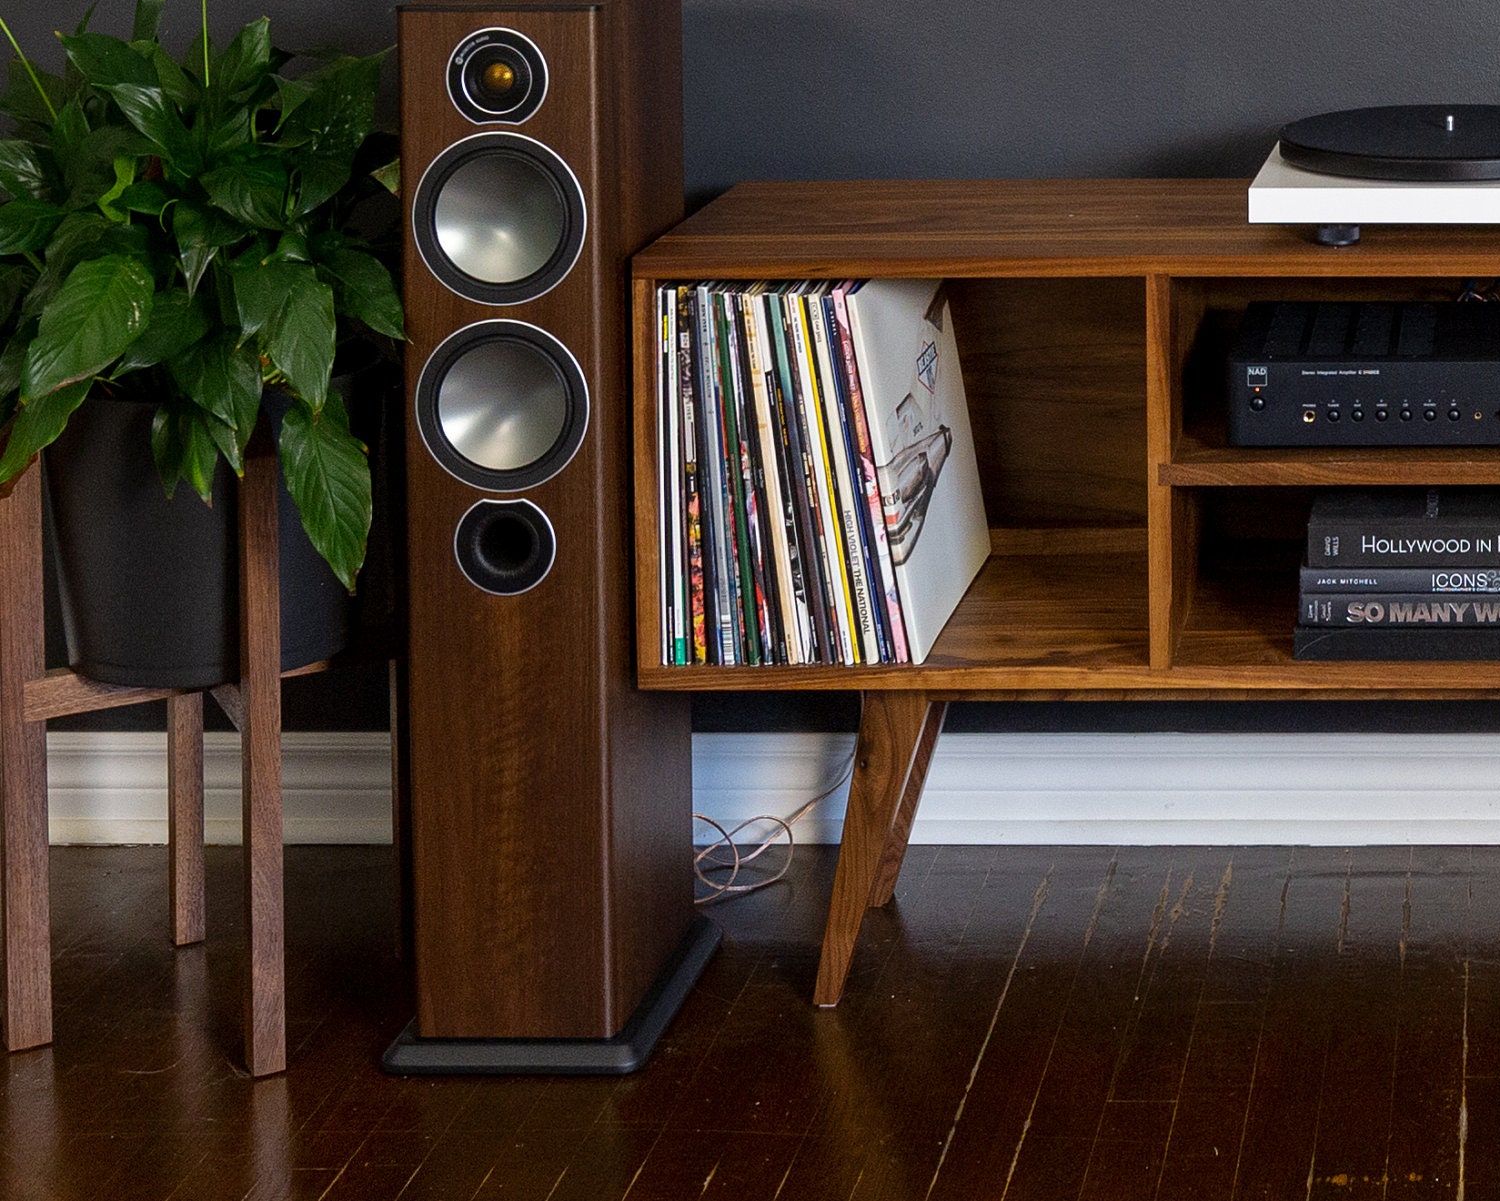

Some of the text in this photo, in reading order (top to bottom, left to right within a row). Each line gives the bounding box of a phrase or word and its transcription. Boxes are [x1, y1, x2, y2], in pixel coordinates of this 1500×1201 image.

[1362, 536, 1471, 553] HOLLYWOOD
[1476, 539, 1492, 553] IN
[843, 509, 870, 635] HIGH VIOLET THE NATIONAL
[1432, 573, 1488, 588] ICONS
[1346, 601, 1385, 623] SO
[1389, 602, 1469, 623] MANY
